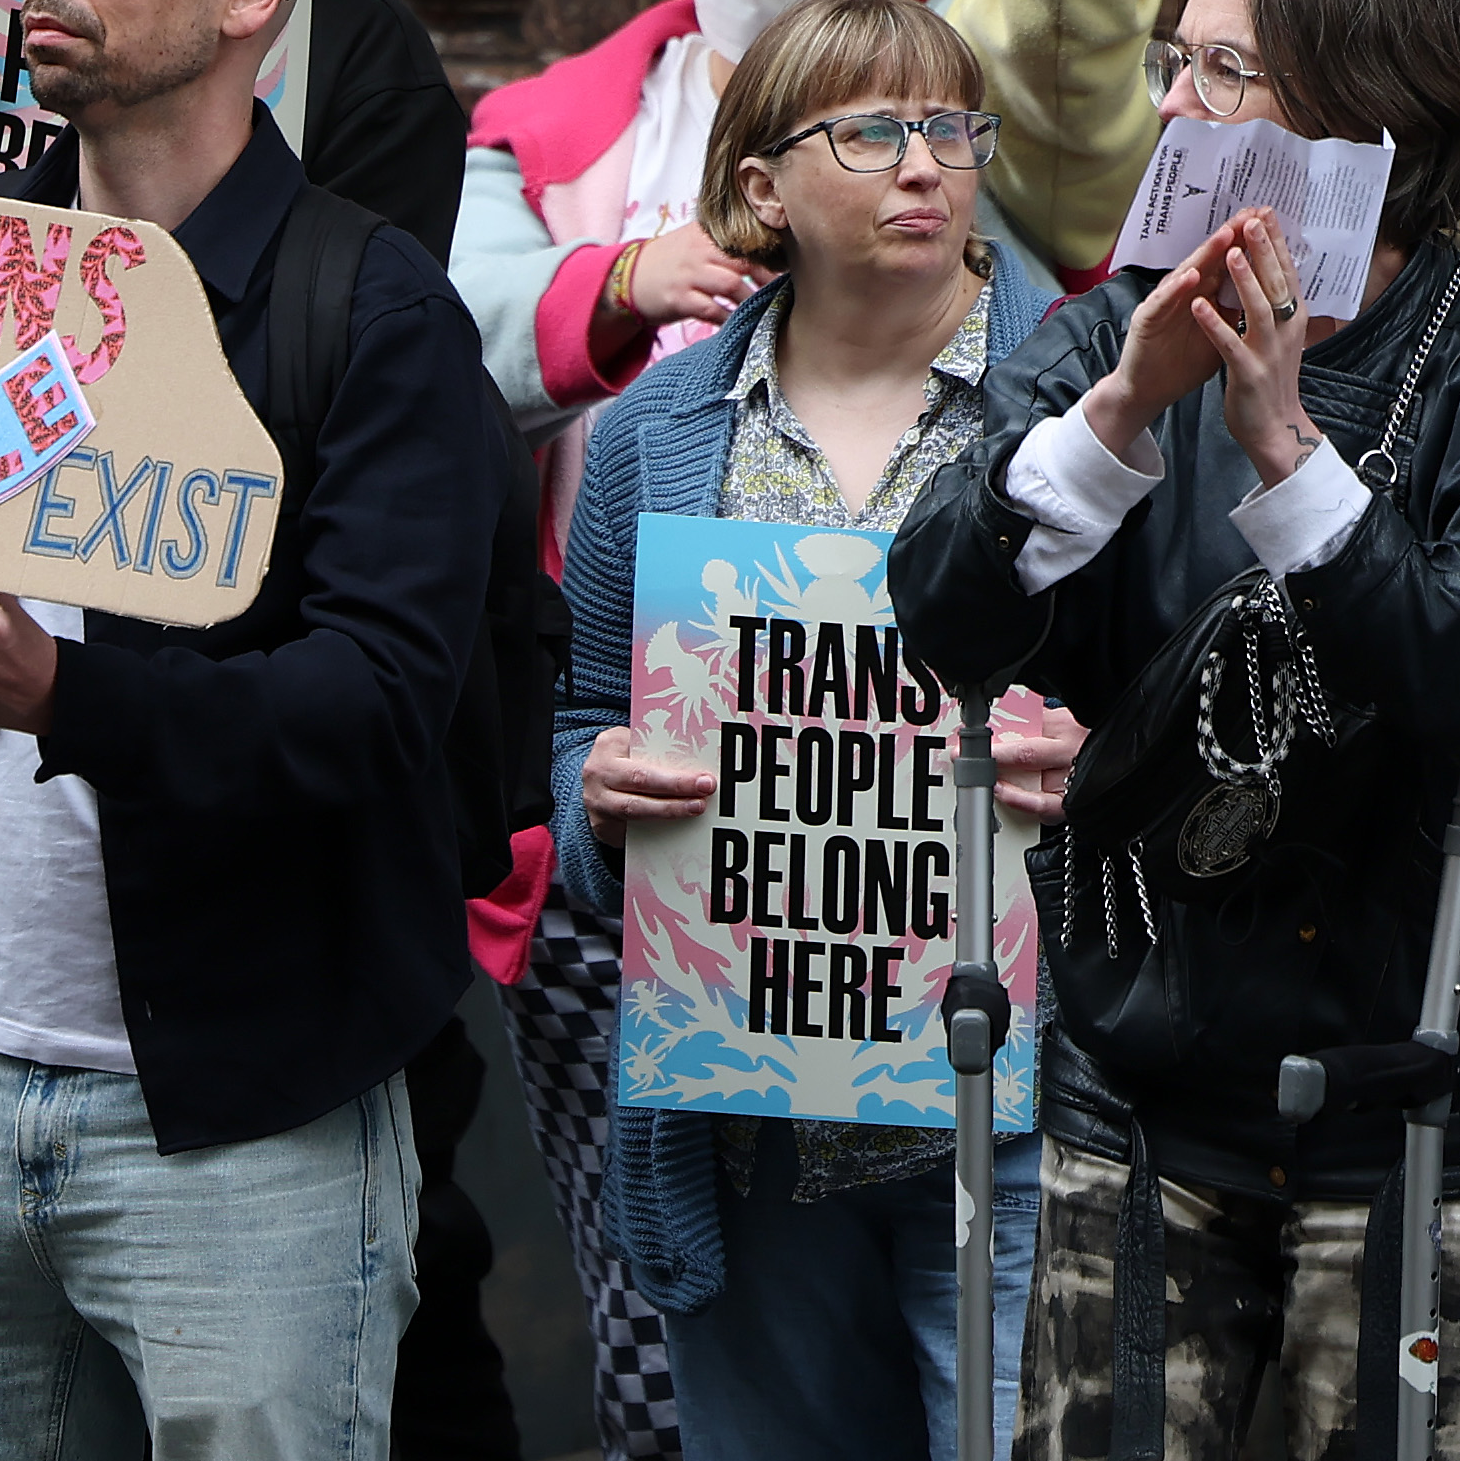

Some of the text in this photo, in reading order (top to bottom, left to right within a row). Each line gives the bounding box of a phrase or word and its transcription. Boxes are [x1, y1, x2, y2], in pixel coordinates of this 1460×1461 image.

[1139, 143, 1170, 241] TAKE ACTION FOR
[1154, 193, 1174, 235] TRANS
[23, 446, 277, 588] EXIST
[728, 615, 941, 726] TRANS
[718, 721, 946, 833] PEOPLE
[709, 827, 950, 941] BELONG
[748, 936, 905, 1044] HERE
